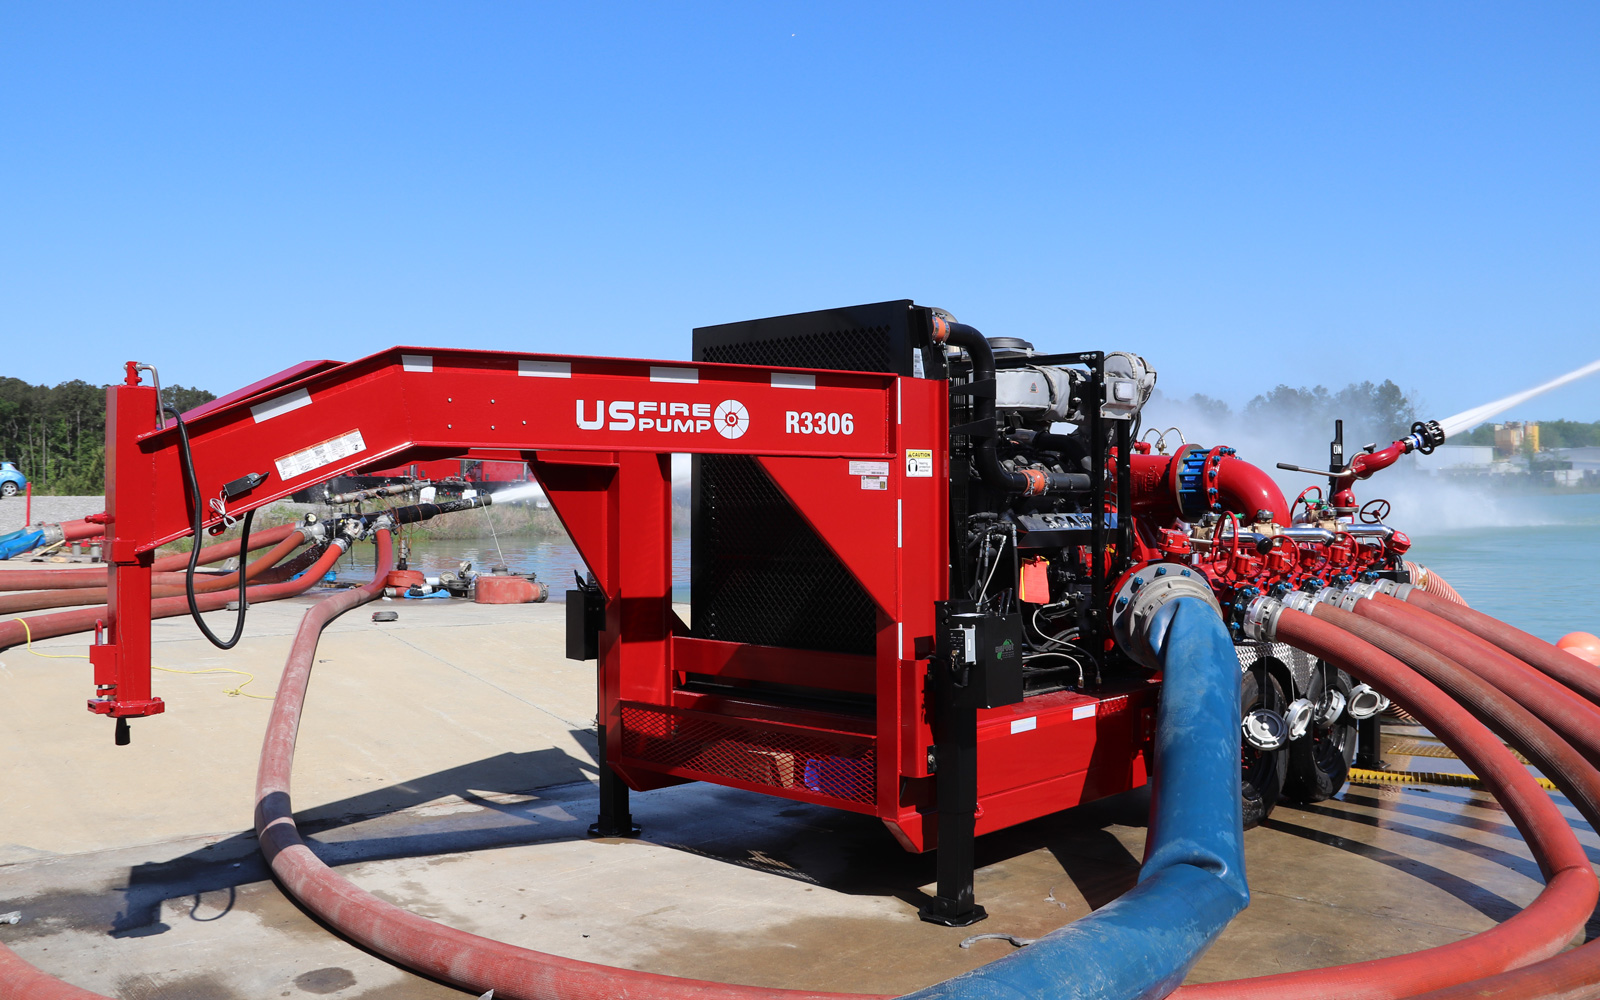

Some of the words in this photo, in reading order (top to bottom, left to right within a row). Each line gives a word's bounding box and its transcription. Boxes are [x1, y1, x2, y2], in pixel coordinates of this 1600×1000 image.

[576, 399, 635, 431] US
[638, 401, 711, 416] FIRE
[638, 418, 711, 433] PUMP
[785, 411, 854, 435] R3306
[1333, 445, 1342, 454] ON
